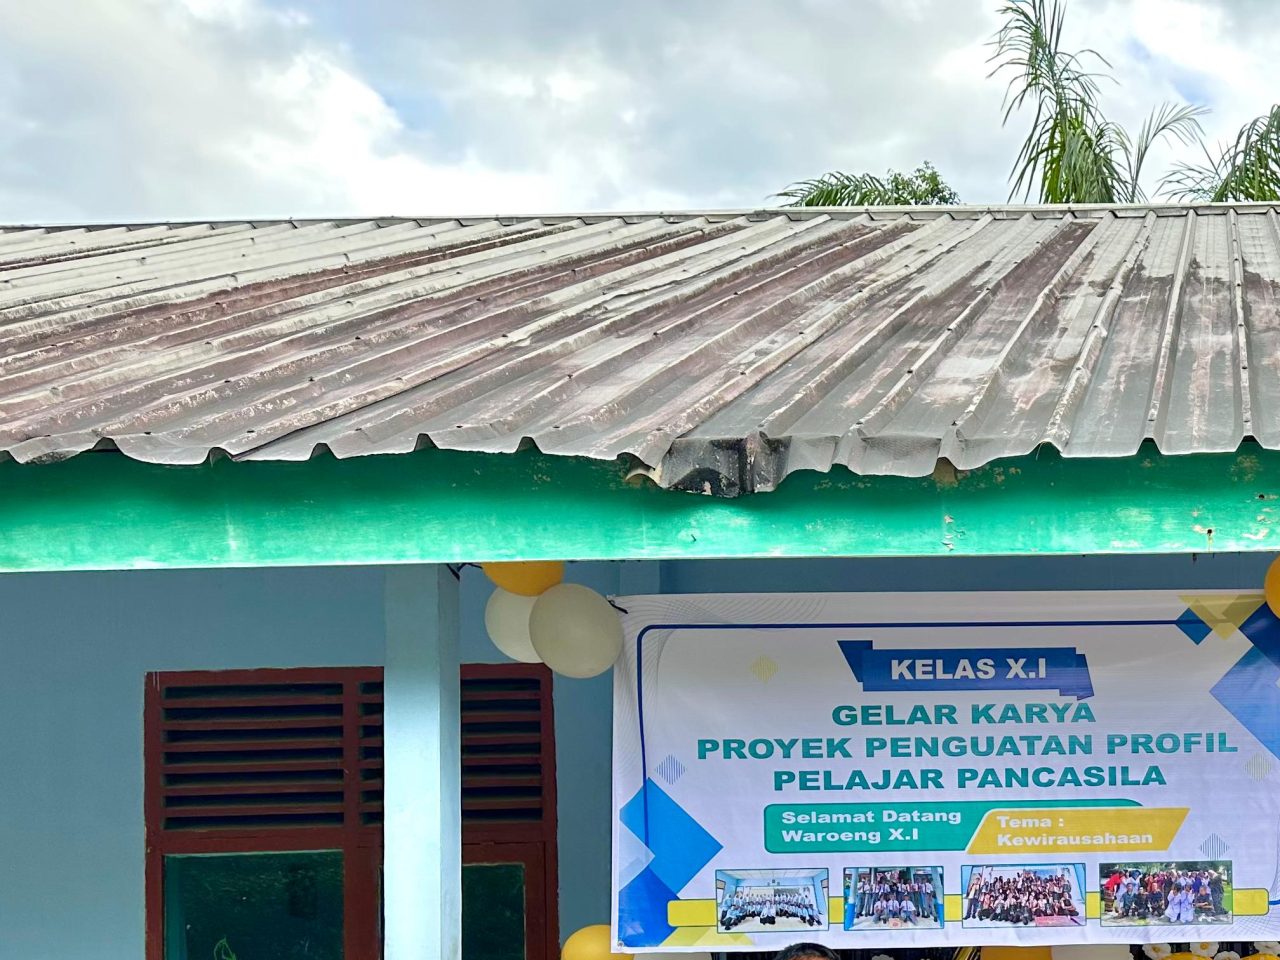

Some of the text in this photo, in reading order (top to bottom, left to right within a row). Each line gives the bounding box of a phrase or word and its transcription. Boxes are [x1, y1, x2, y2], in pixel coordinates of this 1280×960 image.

[891, 657, 1047, 680] KELAS X.I
[831, 702, 1097, 726] GELAR KARYA
[697, 731, 1239, 760] PROYEK PENGUATAN PROFIL
[773, 765, 1167, 791] PELAJAR PANCASILA
[781, 809, 962, 824] Selamat Datang
[996, 815, 1052, 829] Tema
[781, 828, 919, 843] Waroeng X.I
[996, 832, 1153, 847] Kewirausahaan
